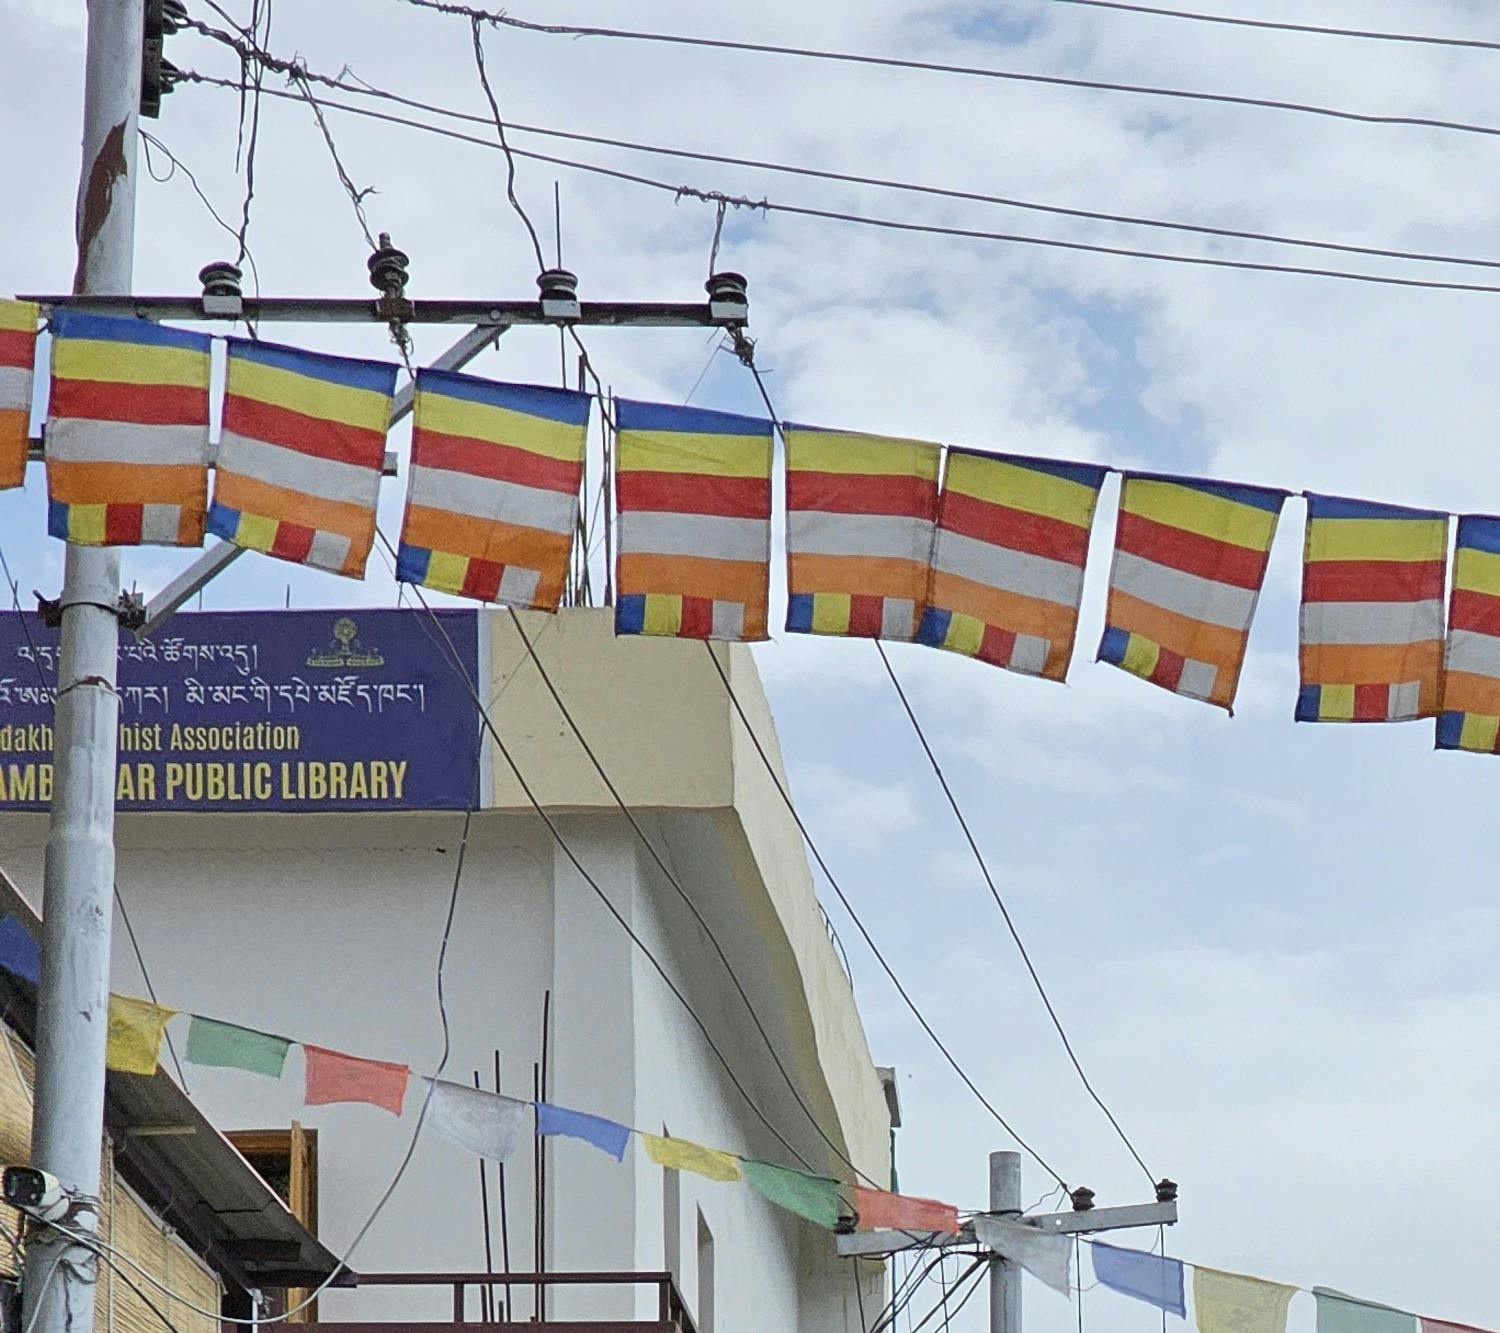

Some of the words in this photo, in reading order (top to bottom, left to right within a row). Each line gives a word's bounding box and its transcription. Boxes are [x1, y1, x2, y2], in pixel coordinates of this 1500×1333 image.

[170, 721, 300, 751] Association
[166, 762, 272, 801] PUBLIC
[281, 760, 408, 801] LIBRARY
